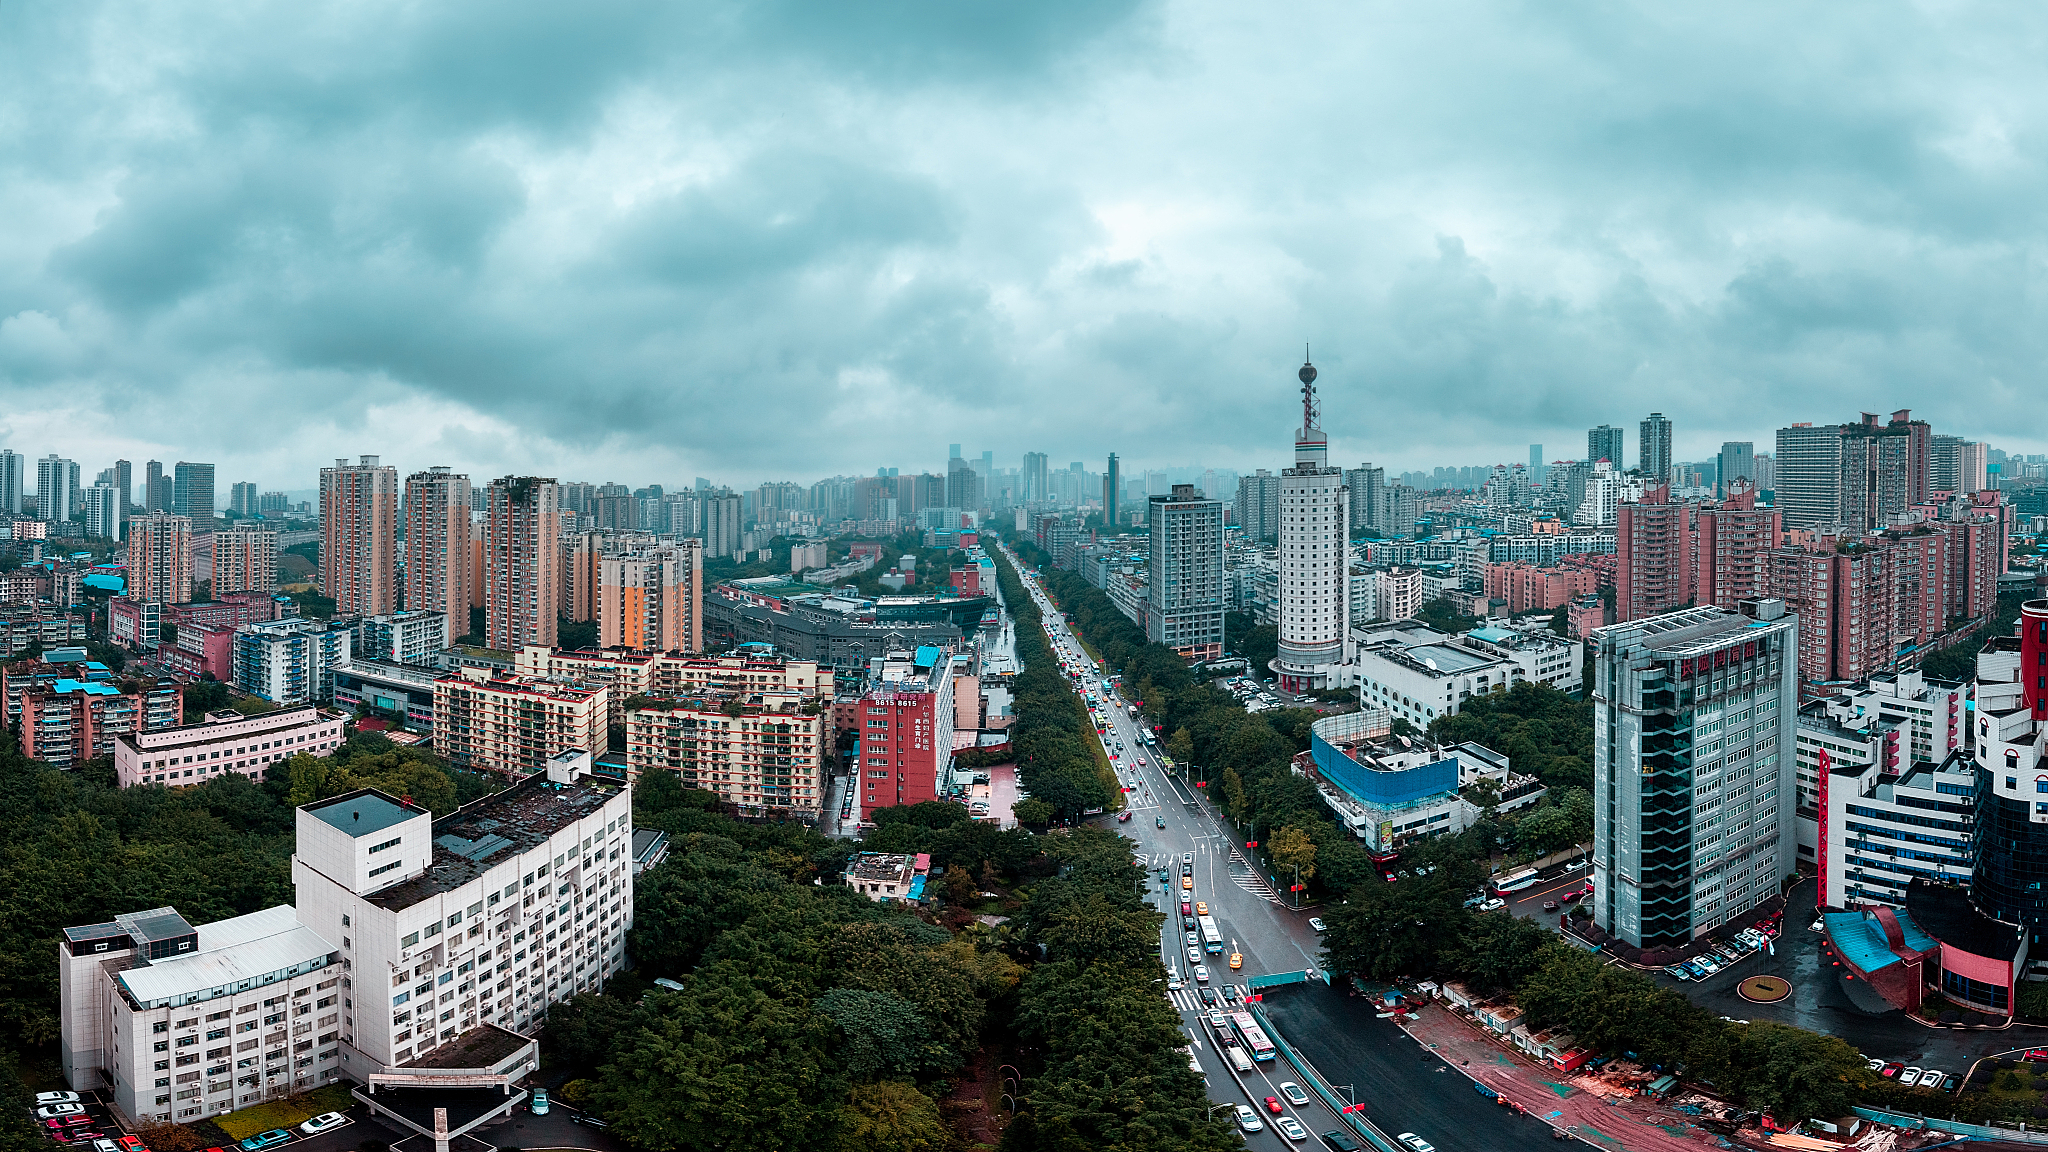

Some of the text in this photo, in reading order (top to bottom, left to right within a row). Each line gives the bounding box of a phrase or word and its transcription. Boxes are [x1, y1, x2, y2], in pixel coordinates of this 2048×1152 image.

[1681, 641, 1755, 677] 长城润滑油
